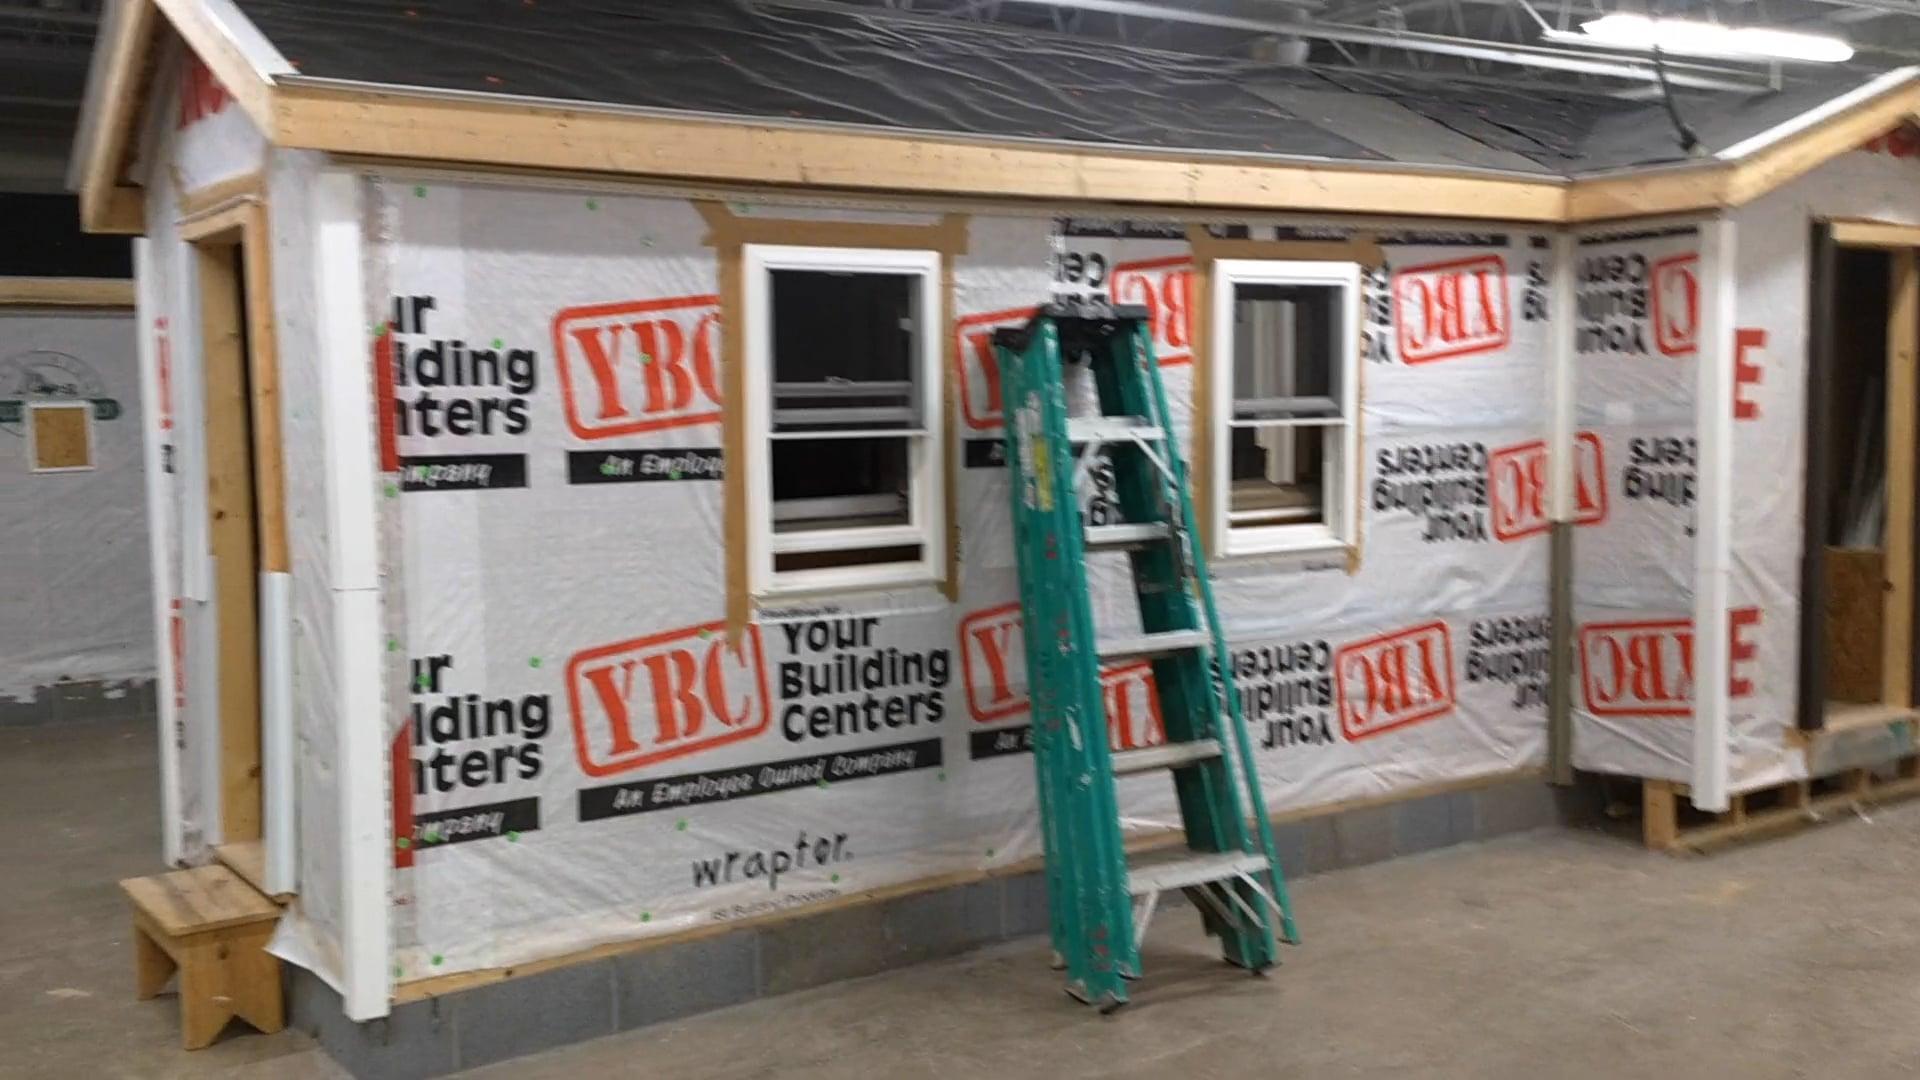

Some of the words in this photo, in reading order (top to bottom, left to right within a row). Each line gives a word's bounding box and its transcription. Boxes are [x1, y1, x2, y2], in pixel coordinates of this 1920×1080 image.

[1404, 269, 1504, 349] YBC
[568, 312, 722, 420] YBC
[779, 617, 879, 654] Your
[582, 638, 753, 757] YBC
[780, 648, 950, 699] Building
[1350, 638, 1446, 725] YBC
[782, 691, 946, 743] Centers
[830, 748, 918, 777] Company
